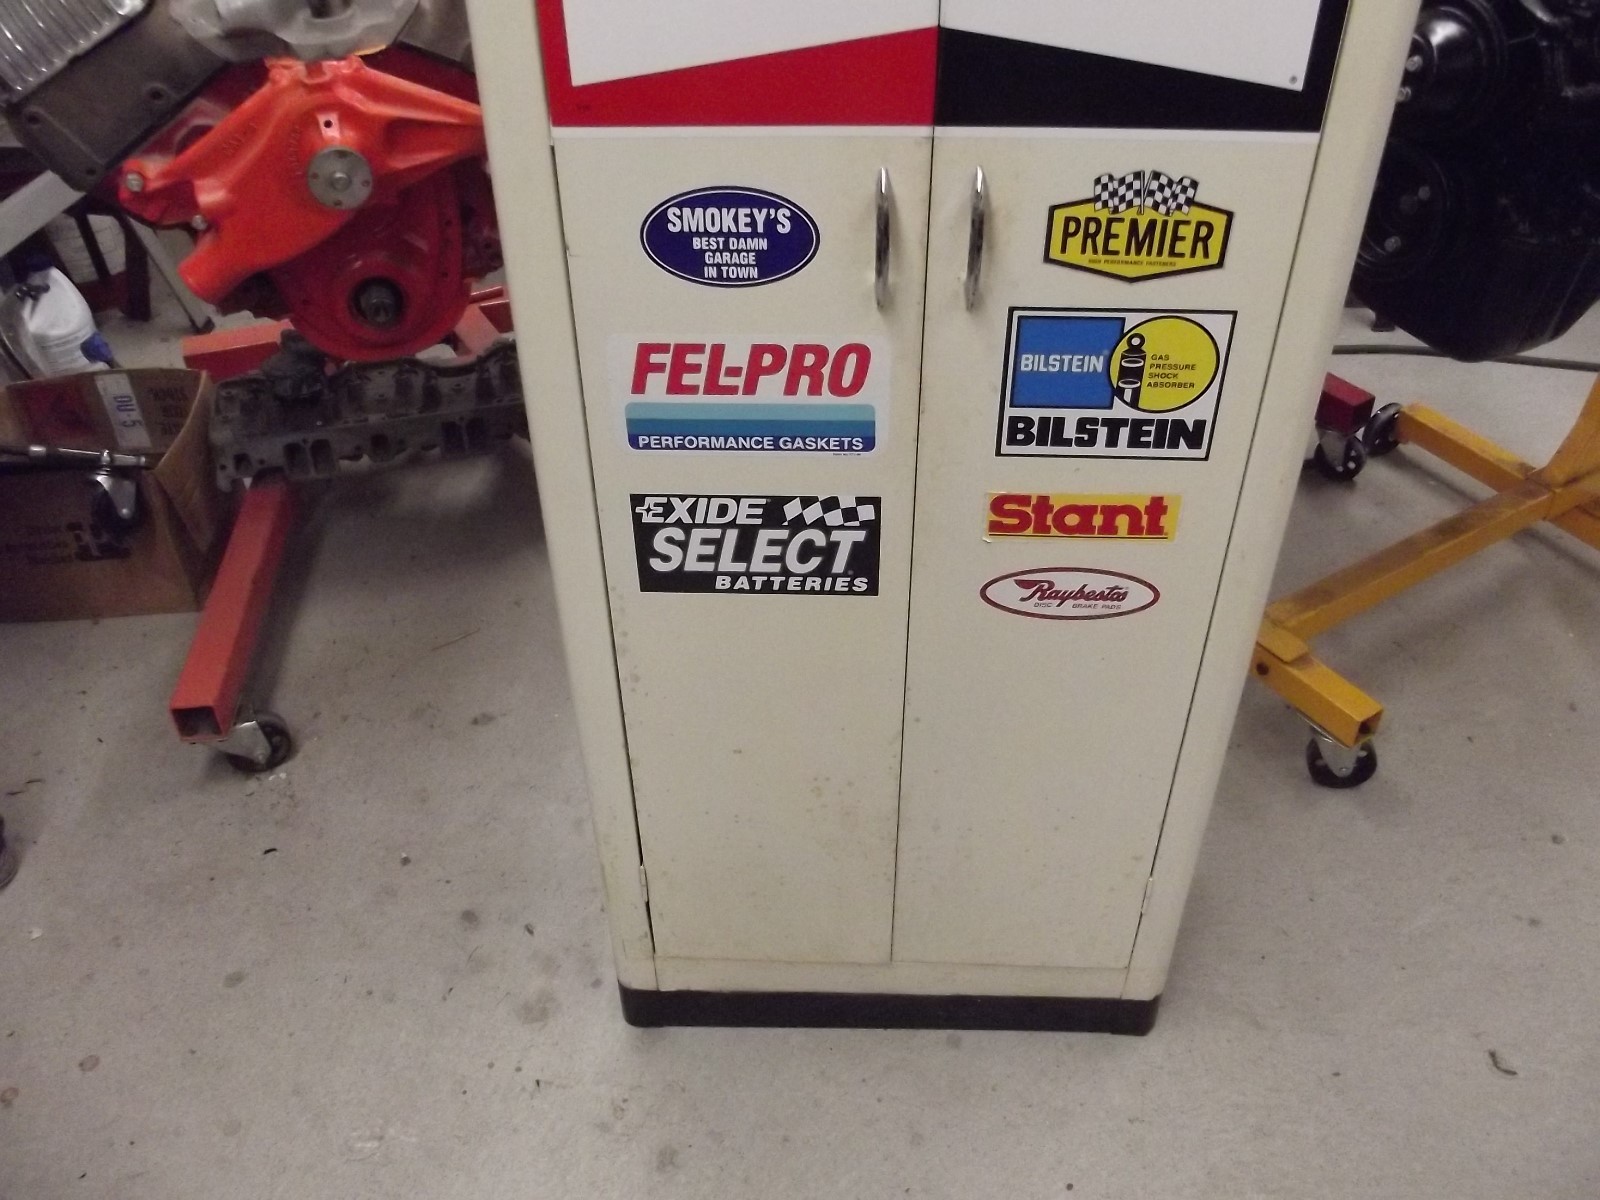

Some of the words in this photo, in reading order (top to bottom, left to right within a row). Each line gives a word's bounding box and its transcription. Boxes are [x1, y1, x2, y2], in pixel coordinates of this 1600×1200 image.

[667, 207, 791, 233] SMOKEY'S
[692, 237, 725, 250] BEST
[729, 238, 768, 250] DAMN
[1060, 216, 1214, 259] PREMIER
[704, 252, 756, 265] GARAGE
[704, 266, 717, 278] IN
[721, 266, 758, 279] TOWN
[631, 343, 872, 397] FEL-PRO
[1020, 354, 1103, 373] BILSTEIN
[1147, 381, 1196, 389] ABSORBER
[1148, 372, 1179, 380] SHOCK
[638, 436, 774, 449] PERFORMANCE
[778, 437, 863, 450] GASKETS
[1006, 416, 1207, 450] BILSTEIN
[635, 497, 767, 525] EXIDE
[988, 494, 1168, 536] Stant
[649, 527, 867, 574] SELECT
[715, 575, 869, 592] BATTERIES
[1014, 579, 1129, 607] Raybestos
